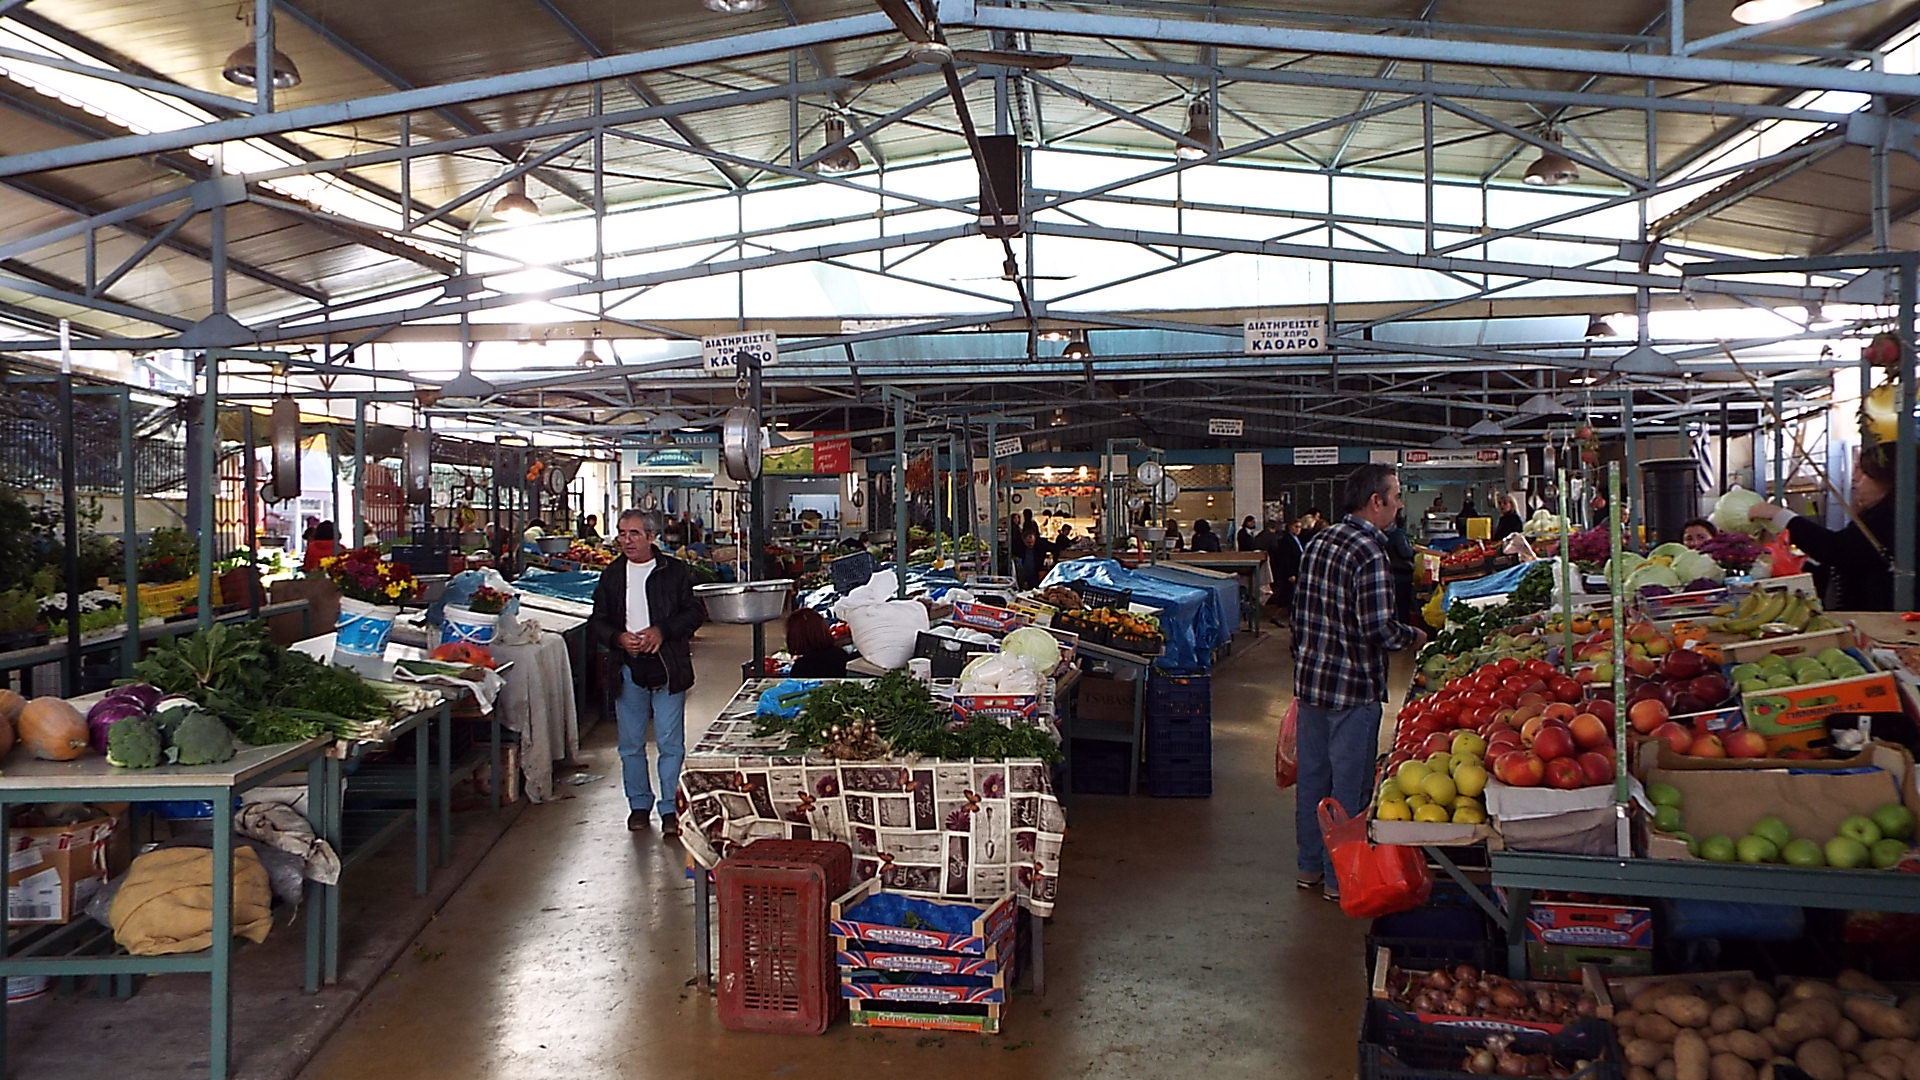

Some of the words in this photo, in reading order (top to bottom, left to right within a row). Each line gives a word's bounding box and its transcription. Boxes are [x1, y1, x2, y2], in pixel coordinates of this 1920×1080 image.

[1247, 320, 1320, 331] ΔΙΑΤΗΡΕΙΣΤΕ
[1284, 330, 1309, 338] ΧΩΡΟ
[705, 333, 772, 348] ΔΙΑΤΗΡΕΙΣΤΕ
[1252, 338, 1319, 351] ΚΑΘΑΡΟ
[717, 347, 734, 355] ΤΟΝ
[710, 351, 772, 367] ΚΑΘΟ
